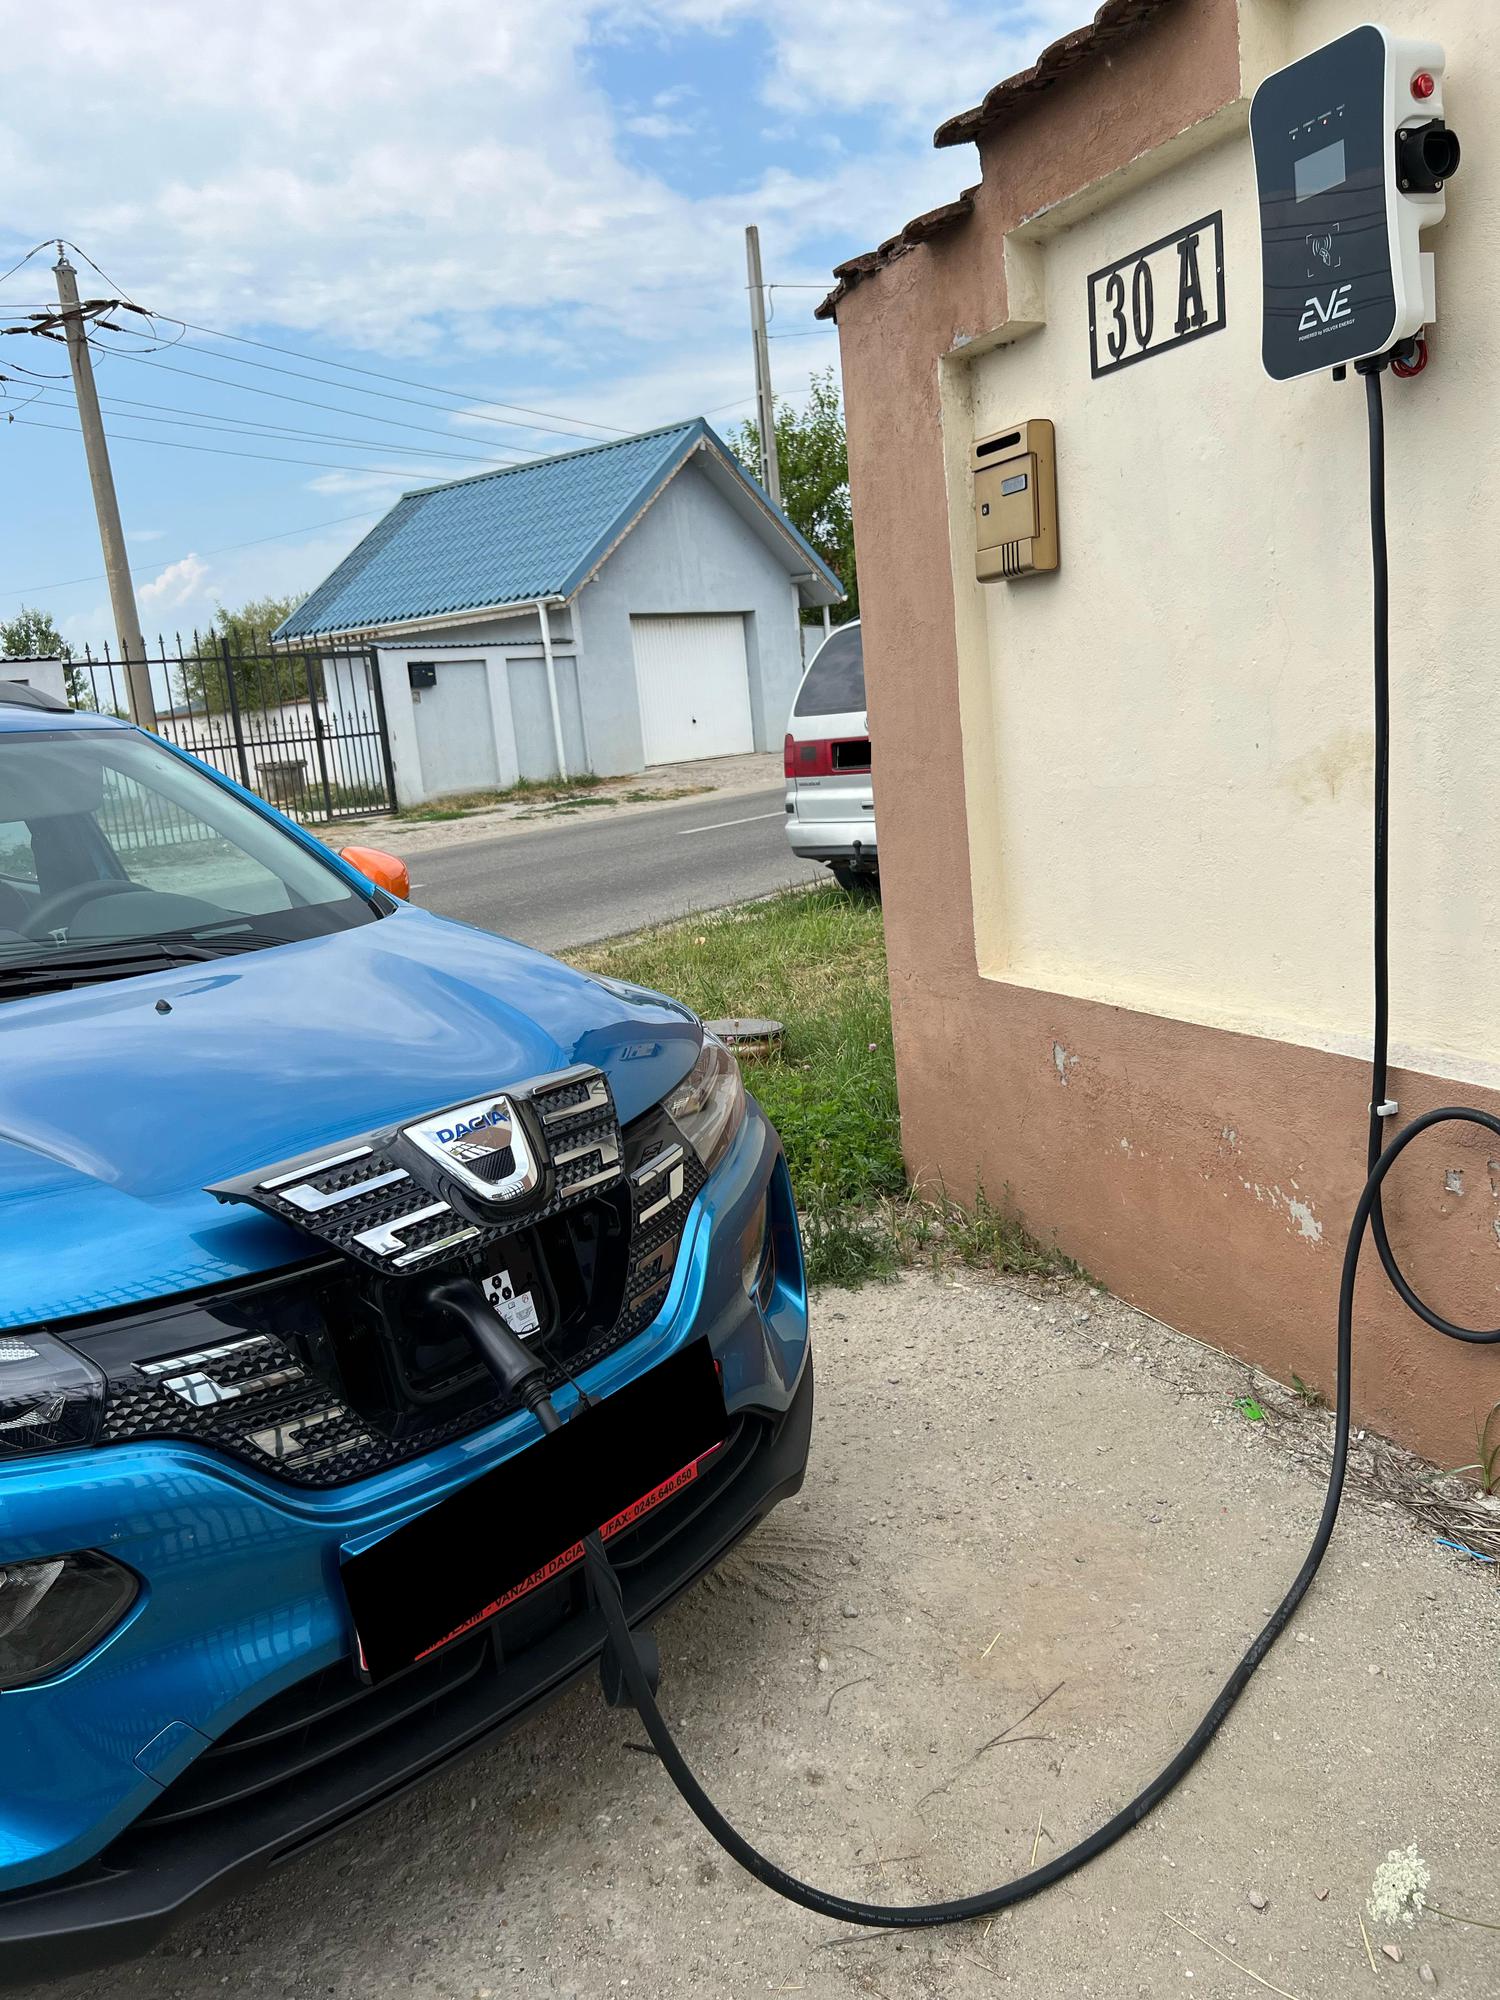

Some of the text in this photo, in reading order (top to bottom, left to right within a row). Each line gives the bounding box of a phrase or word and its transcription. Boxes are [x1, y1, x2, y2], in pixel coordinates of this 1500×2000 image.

[1106, 233, 1208, 358] 30 A
[1298, 284, 1352, 331] EVE
[1298, 331, 1318, 341] POWERED
[436, 1110, 508, 1144] DACIA
[549, 1543, 585, 1574] DACIA
[600, 1512, 631, 1540] L/FAX:
[633, 1468, 692, 1516] 0245.640.650
